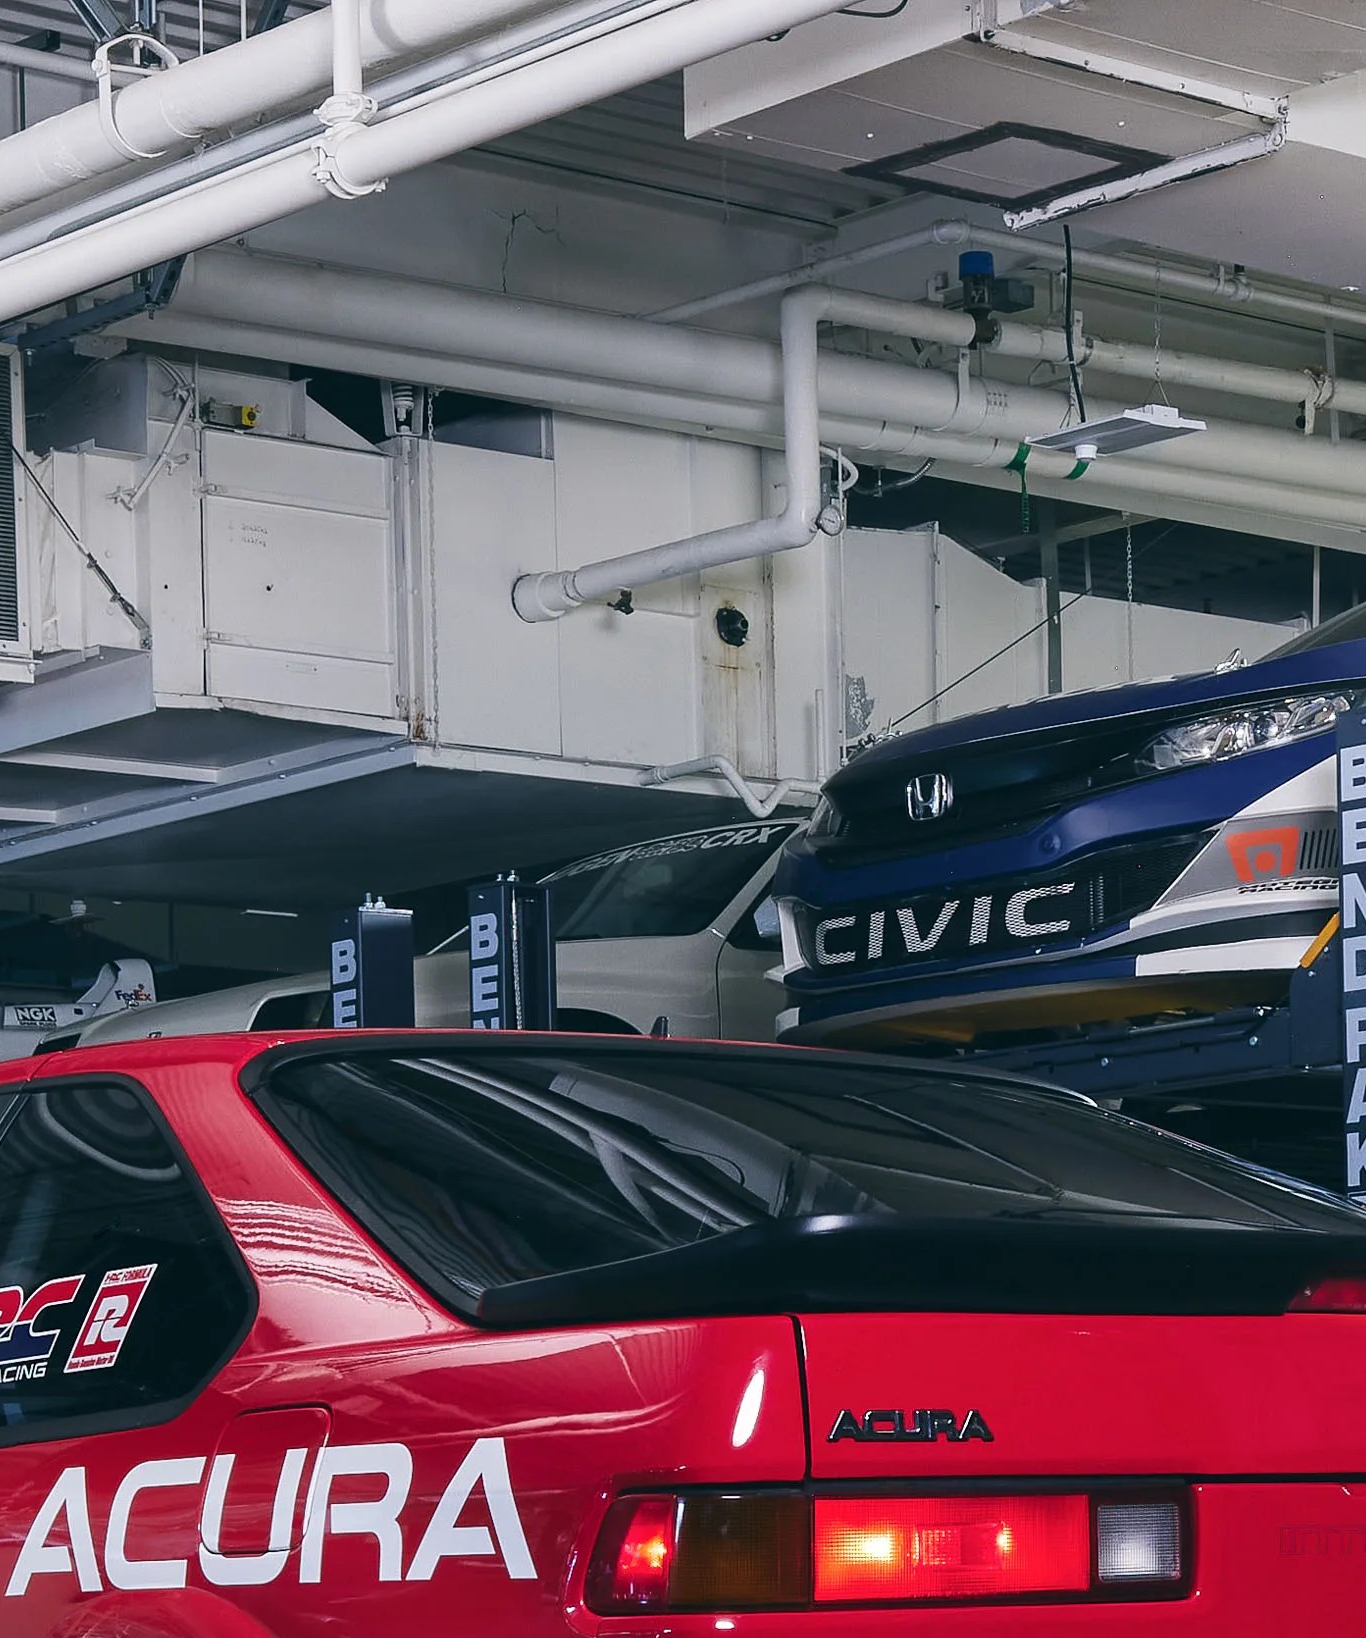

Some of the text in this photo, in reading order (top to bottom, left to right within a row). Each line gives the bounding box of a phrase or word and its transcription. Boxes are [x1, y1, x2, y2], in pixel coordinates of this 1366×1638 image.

[701, 825, 785, 849] CRX
[815, 882, 1074, 965] CIVIC
[115, 988, 152, 1002] FedEx
[17, 1007, 56, 1023] NGK
[826, 1409, 994, 1442] ACURA
[5, 1437, 539, 1596] ACURA
